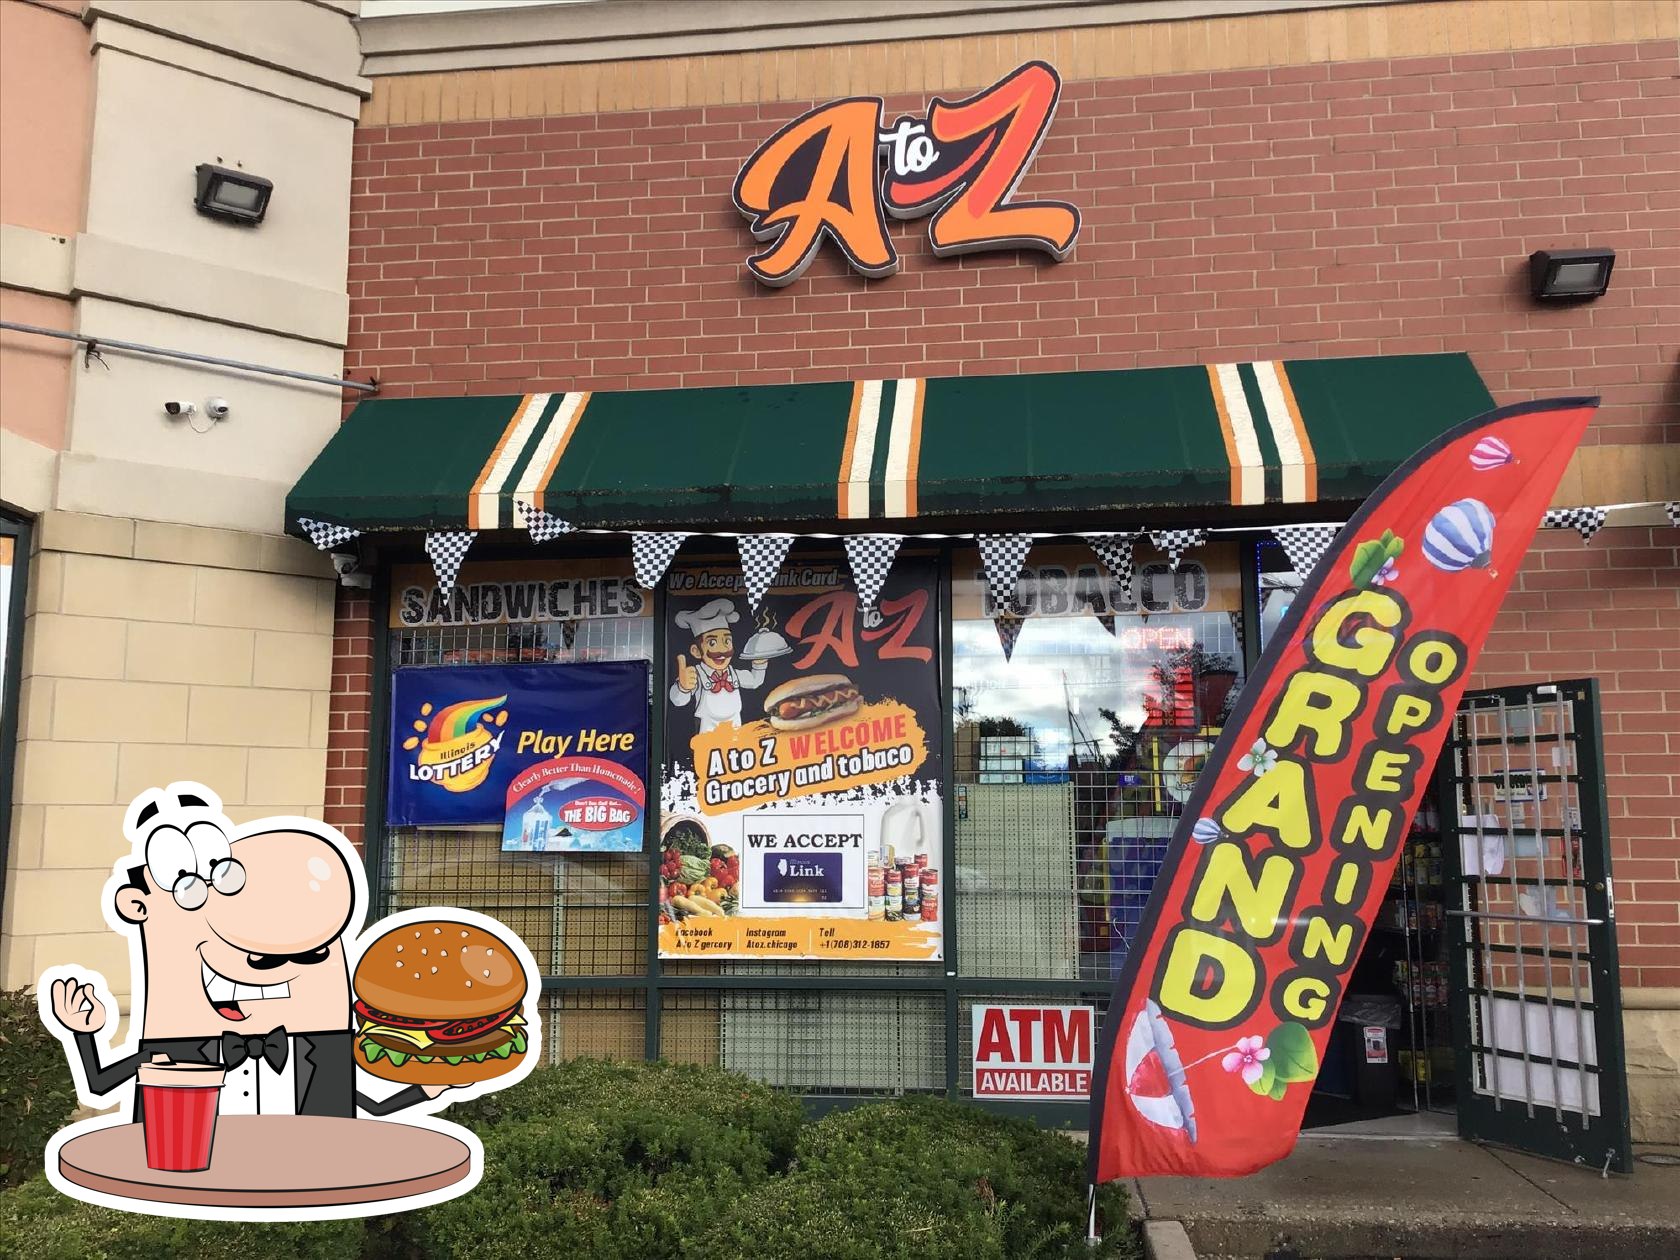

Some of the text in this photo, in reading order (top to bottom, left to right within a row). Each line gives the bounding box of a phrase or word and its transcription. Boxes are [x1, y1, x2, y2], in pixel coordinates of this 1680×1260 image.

[733, 62, 1079, 286] A to Z
[669, 568, 839, 591] We Accep ink Card
[401, 577, 646, 625] SANDWICHES
[785, 588, 932, 670] A to Z
[1121, 627, 1194, 650] OPEN
[409, 730, 505, 781] LOTTERY
[439, 742, 476, 760] Illinois
[517, 728, 635, 758] Play Here
[708, 714, 907, 777] A to Z WELCOME
[512, 763, 641, 794] Clearly Better Than Homemade!
[705, 744, 913, 805] Grocery and tobaco
[564, 805, 631, 823] THE BIG BAG
[1160, 588, 1404, 1025] GRAND
[747, 834, 862, 848] WE ACCEPT
[1282, 638, 1458, 1022] OPENING
[790, 865, 825, 877] Link
[694, 940, 699, 948] Z
[746, 928, 787, 938] Instagram
[819, 928, 835, 937] Tell
[976, 1008, 1091, 1064] ATM
[980, 1072, 1088, 1093] AVAILABLE
